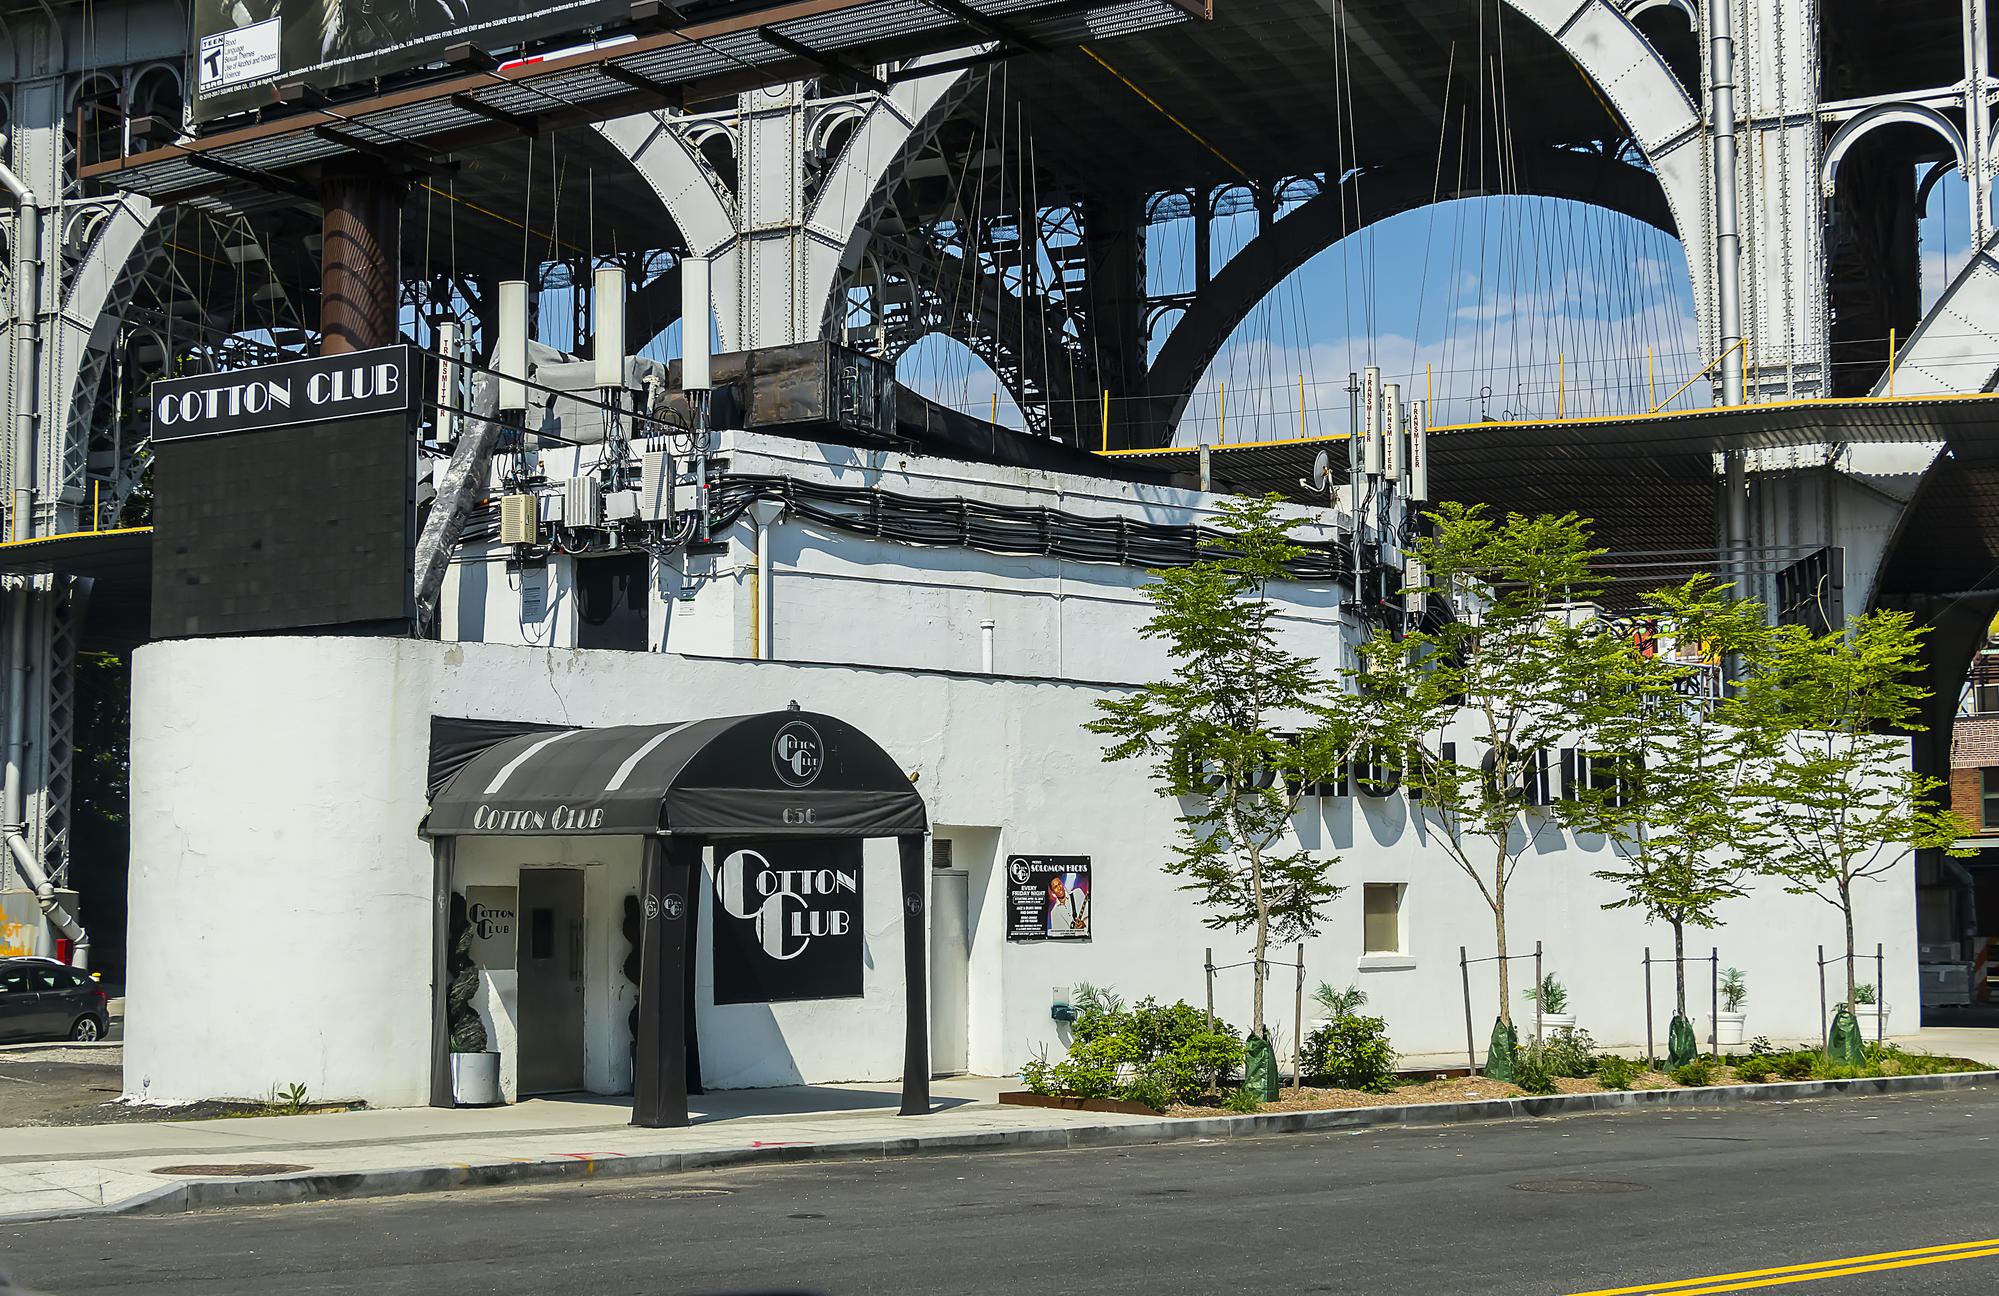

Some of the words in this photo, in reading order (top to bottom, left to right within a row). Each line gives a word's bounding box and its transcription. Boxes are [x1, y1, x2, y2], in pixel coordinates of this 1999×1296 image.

[203, 37, 223, 47] TEEN
[204, 49, 221, 78] T
[200, 80, 222, 91] ESRB
[440, 340, 449, 417] TRNSMITTR
[158, 378, 291, 425] COTTON
[306, 363, 399, 405] CLUB
[1366, 373, 1374, 442] TRANSMITTER
[778, 734, 816, 761] COTTON
[473, 804, 547, 830] COTTON
[551, 804, 604, 830] CLUB
[782, 808, 817, 824] 656
[1030, 864, 1065, 872] SOLOMON
[1066, 864, 1088, 872] HICKS
[716, 849, 857, 919] COTTON
[469, 903, 514, 924] COTTON
[755, 891, 850, 960] CLUB
[477, 919, 509, 940] CLUB
